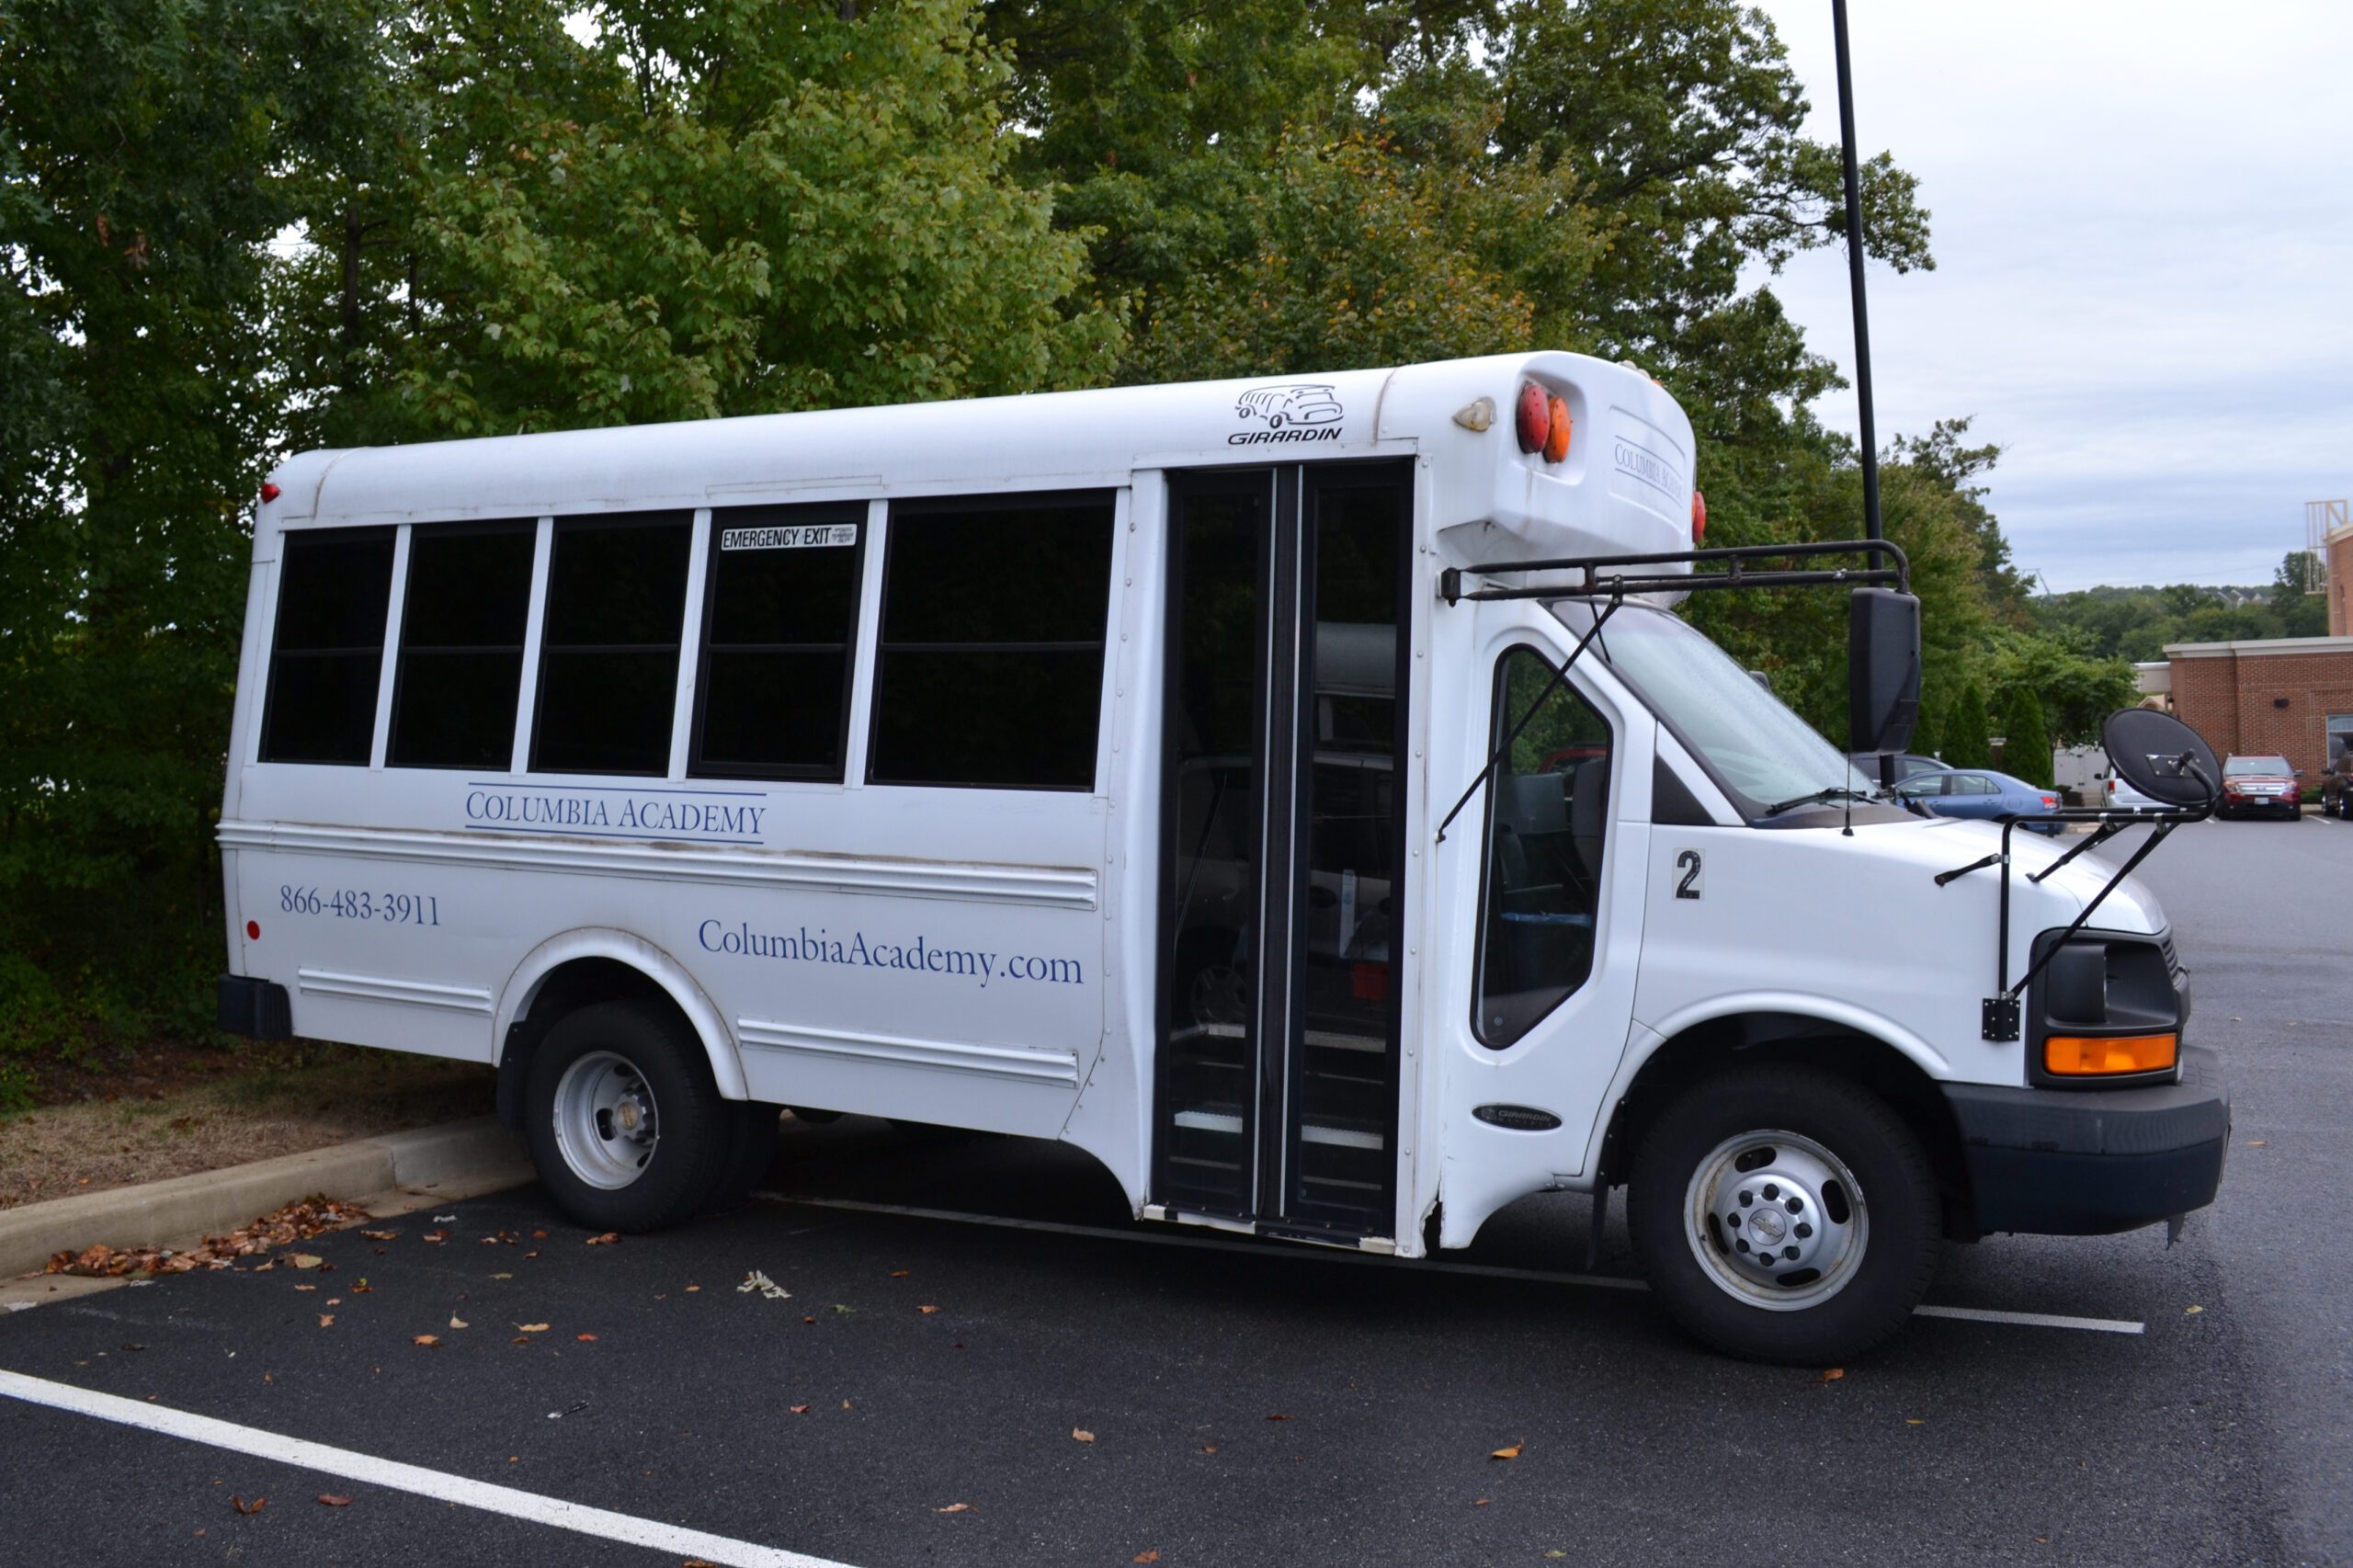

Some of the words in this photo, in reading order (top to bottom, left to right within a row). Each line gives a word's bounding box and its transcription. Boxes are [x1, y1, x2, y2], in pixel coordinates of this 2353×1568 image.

[1228, 427, 1343, 446] GIRARDIN
[722, 528, 800, 549] EMERGENCY
[804, 527, 832, 545] EXIT
[466, 790, 610, 827] COLUMBIA
[619, 798, 767, 835] ACADEMY
[1675, 850, 1701, 900] 2
[279, 885, 441, 926] 866-483-3911
[699, 919, 1085, 988] ColumbiaAcademy.com
